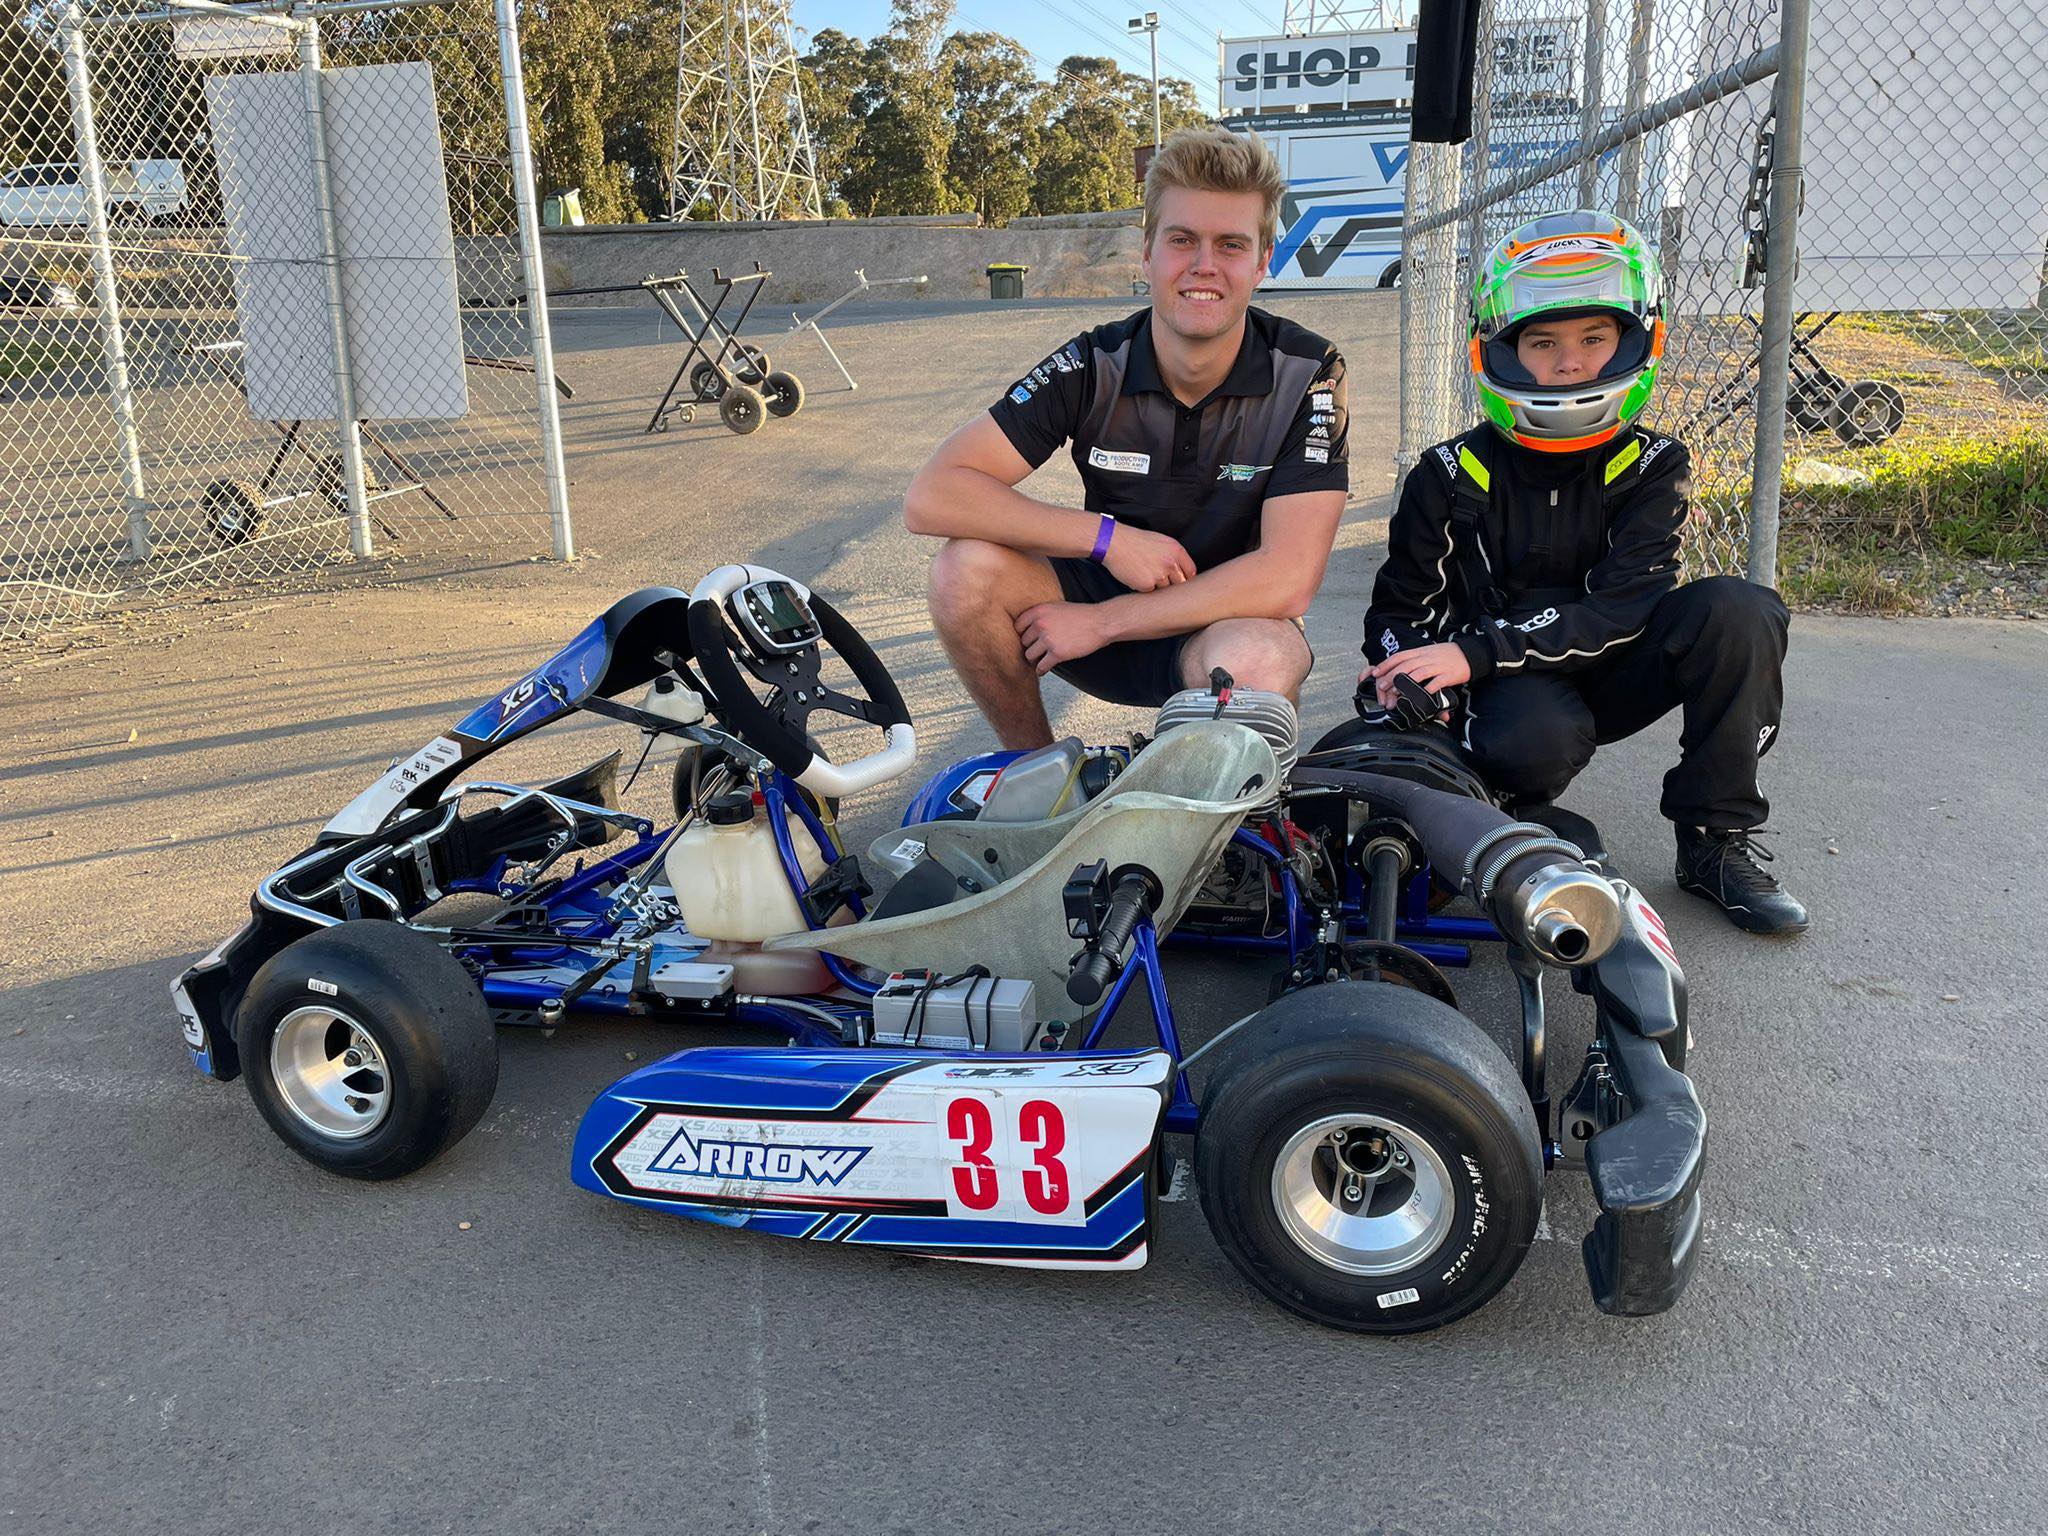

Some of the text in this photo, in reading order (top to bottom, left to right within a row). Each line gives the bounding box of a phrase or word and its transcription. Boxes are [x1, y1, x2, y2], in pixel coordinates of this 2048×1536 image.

[1235, 46, 1381, 92] SHOP
[402, 768, 418, 781] RK
[646, 1126, 873, 1187] ARROW
[947, 1097, 1071, 1215] 33
